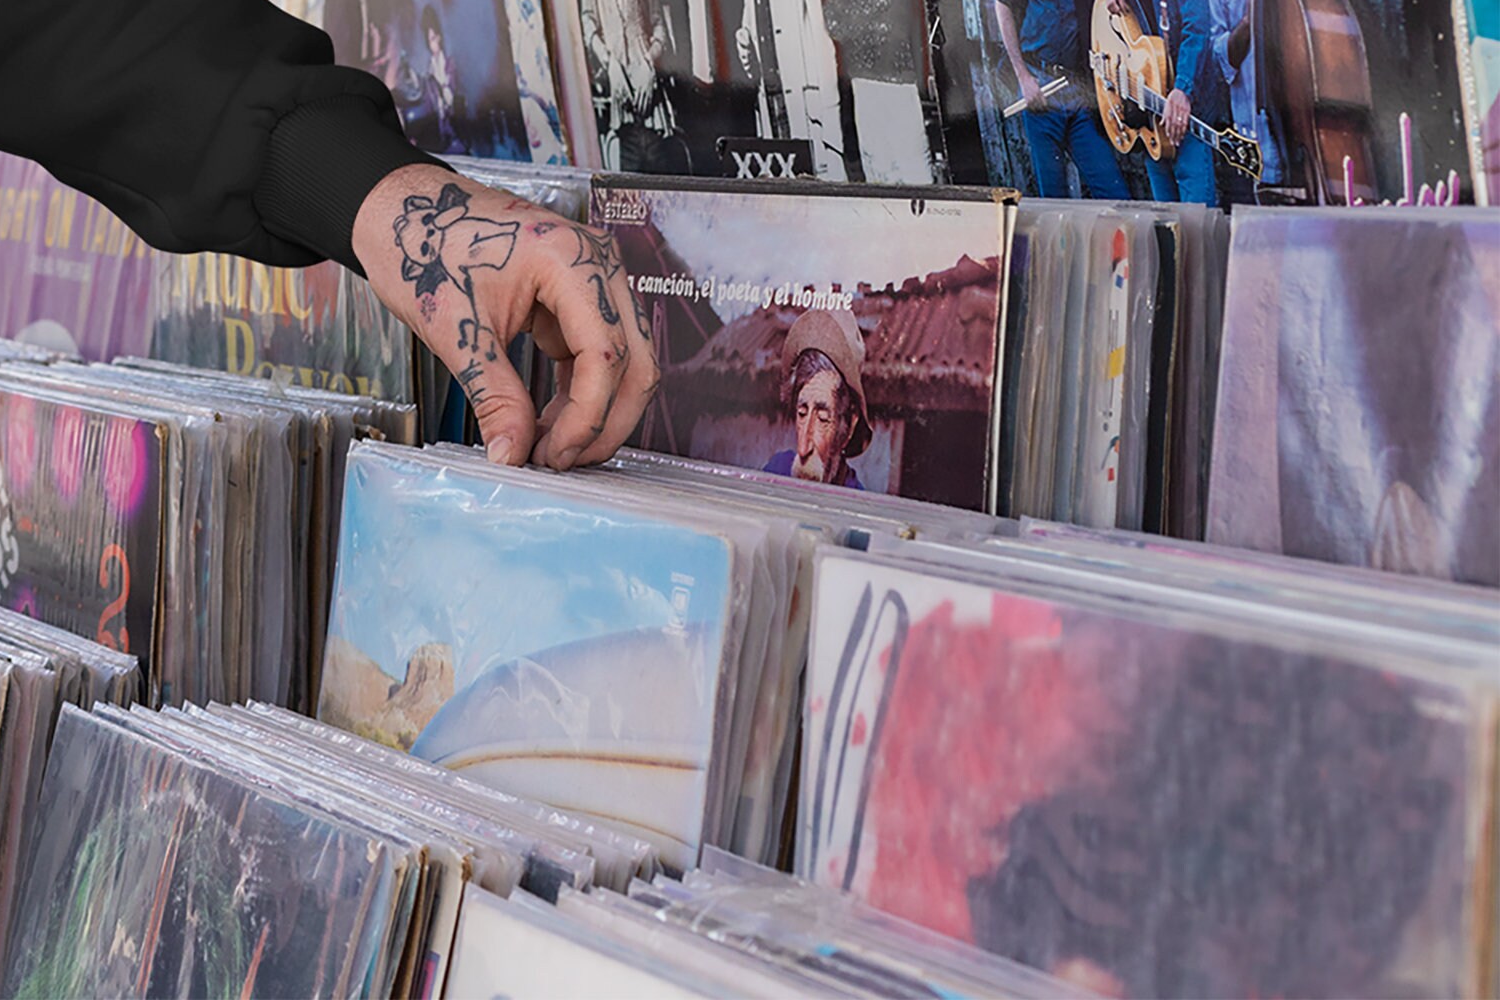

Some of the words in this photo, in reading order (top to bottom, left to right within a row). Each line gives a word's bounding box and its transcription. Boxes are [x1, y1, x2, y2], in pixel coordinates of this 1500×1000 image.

[730, 150, 797, 179] XXX
[45, 187, 78, 249] ON
[700, 275, 716, 299] el
[716, 281, 761, 306] poeta
[762, 287, 776, 311] y
[774, 281, 791, 307] el
[790, 282, 854, 312] hombre
